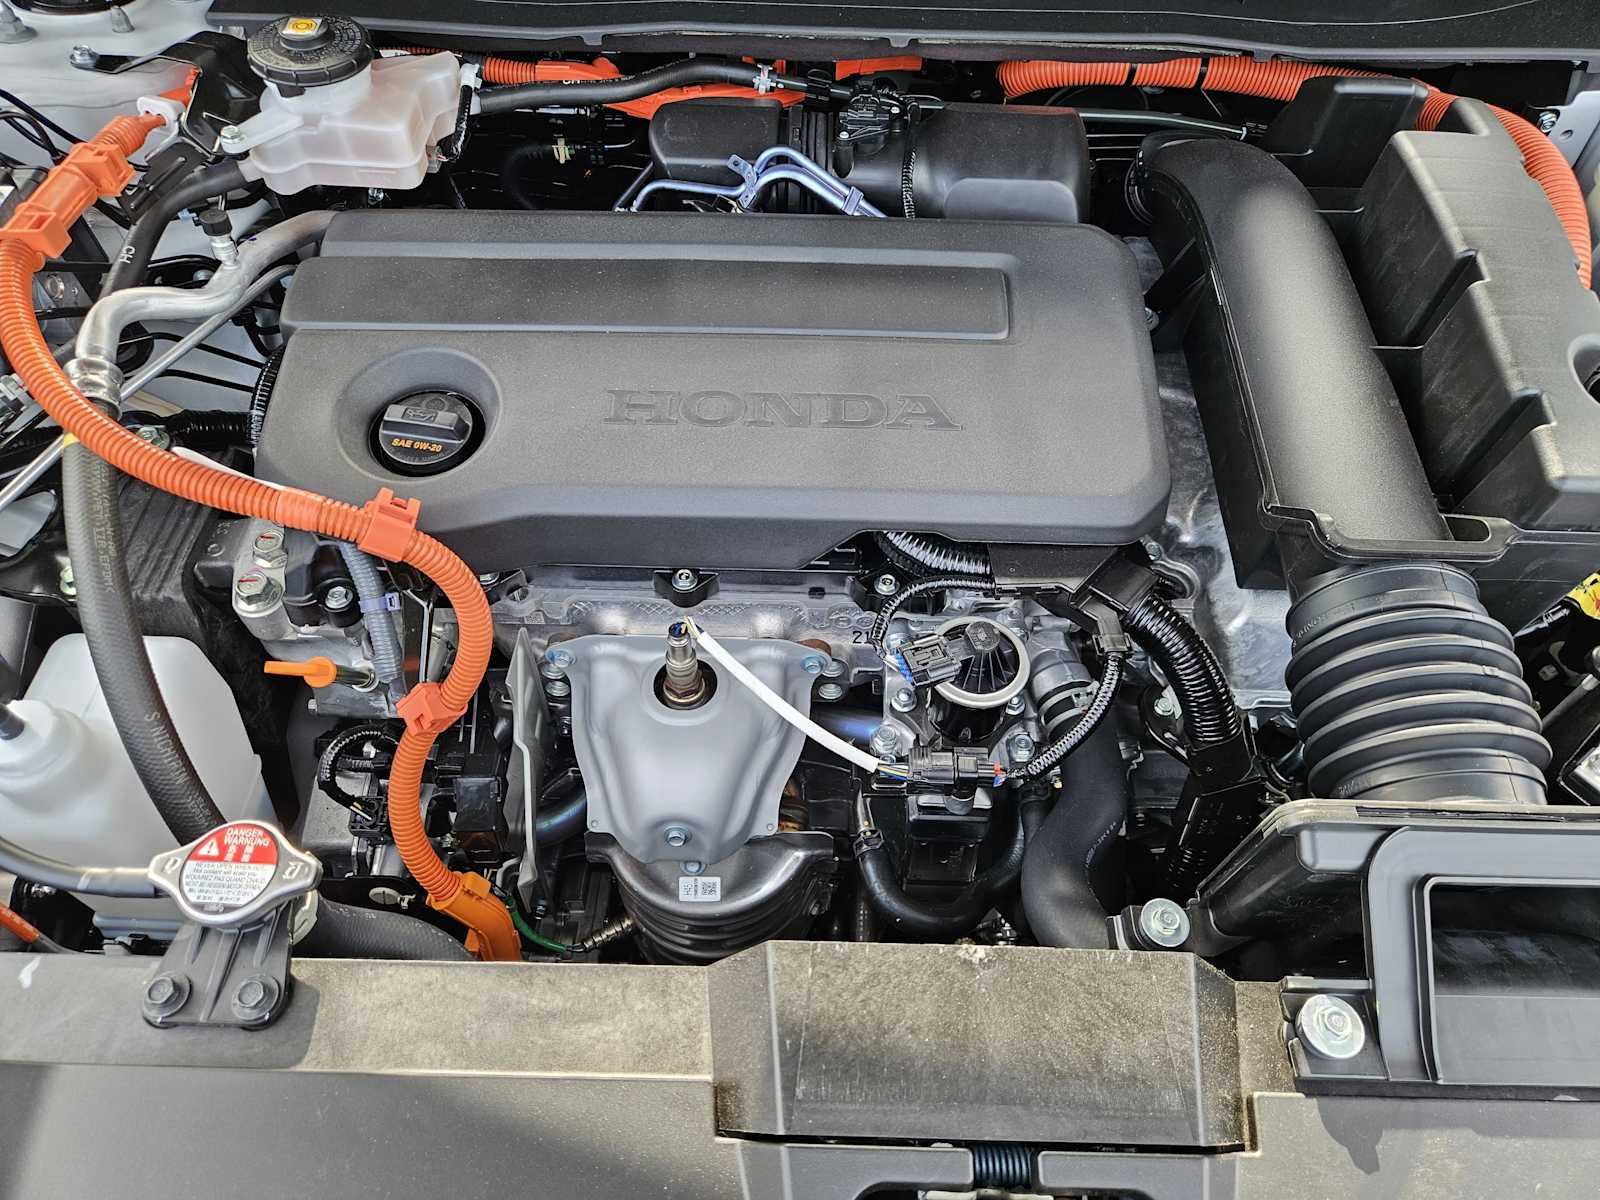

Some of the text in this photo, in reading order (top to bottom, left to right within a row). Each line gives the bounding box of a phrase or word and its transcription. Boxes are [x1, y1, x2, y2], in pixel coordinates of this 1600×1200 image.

[603, 388, 964, 431] HONDA
[392, 438, 442, 452] SAE 0W-20
[852, 631, 871, 644] 21
[226, 828, 264, 838] DANGER
